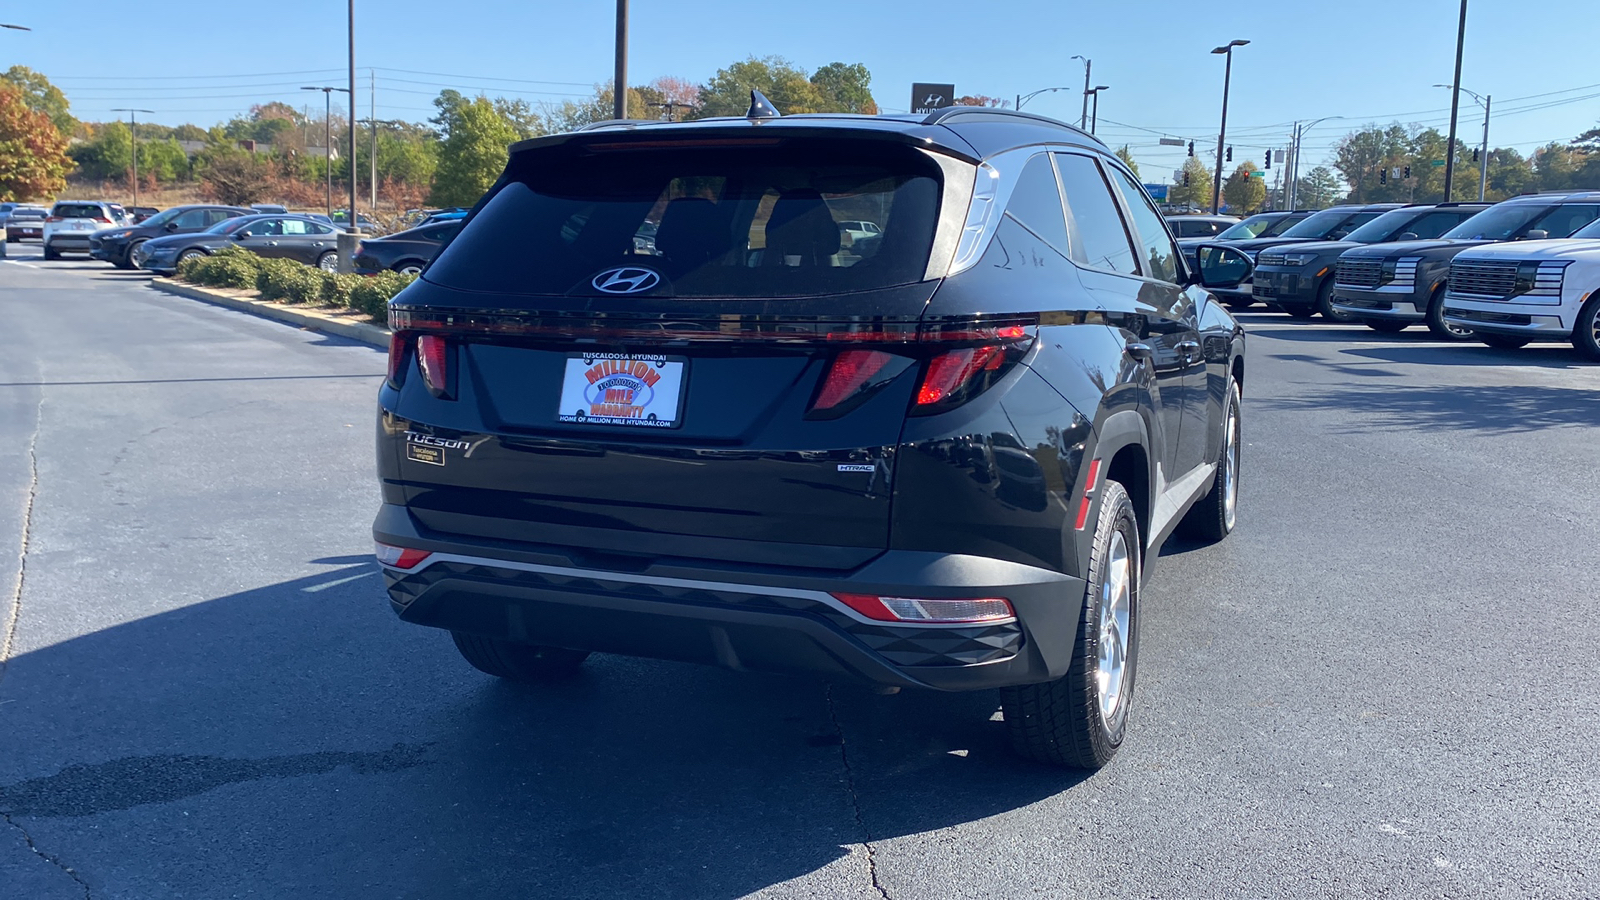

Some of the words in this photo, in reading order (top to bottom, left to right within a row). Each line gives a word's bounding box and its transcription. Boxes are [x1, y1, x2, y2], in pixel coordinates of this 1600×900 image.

[583, 352, 629, 360] TUSCALOOSA
[585, 360, 661, 388] MILLION
[604, 388, 634, 405] MILE
[590, 403, 645, 418] WARRANTY
[627, 419, 671, 427] HYUNDAI.COM
[403, 430, 470, 450] TUCSON
